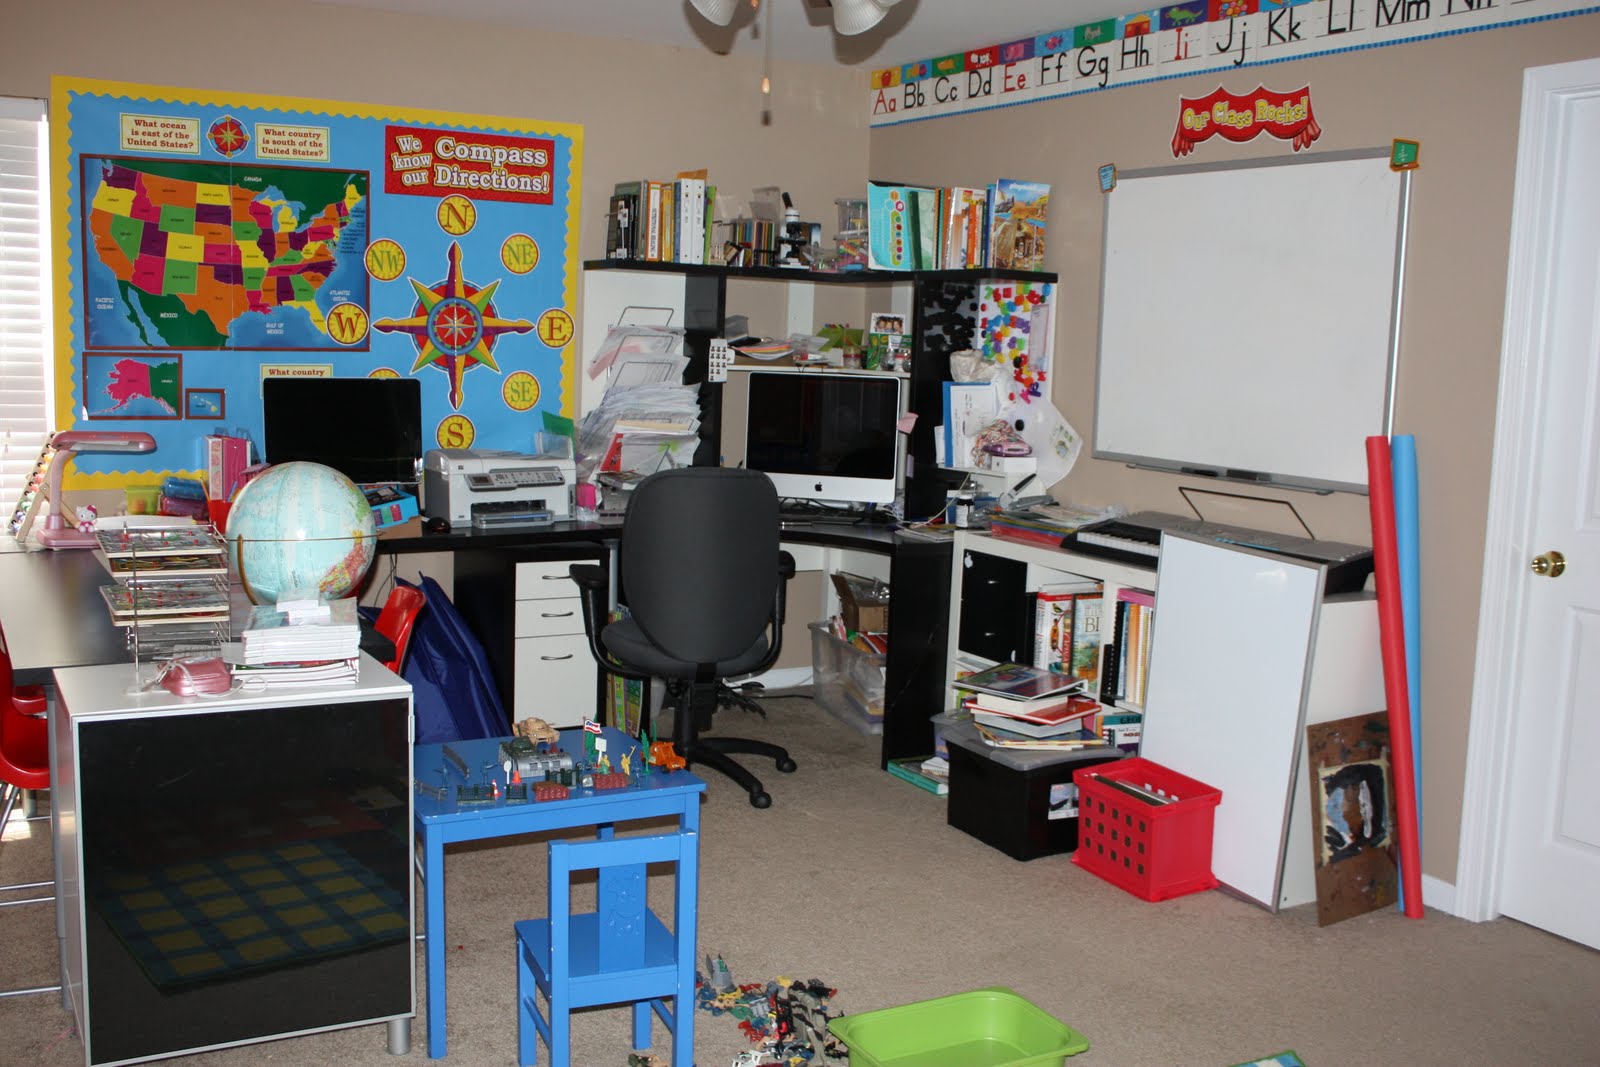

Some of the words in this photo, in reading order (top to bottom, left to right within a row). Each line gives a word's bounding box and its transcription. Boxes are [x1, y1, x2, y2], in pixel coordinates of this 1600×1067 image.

[873, 89, 896, 114] Aa
[904, 81, 925, 109] Bb
[935, 76, 958, 103] Cc
[968, 67, 992, 98] Dd
[1004, 63, 1026, 92] Ee
[1041, 52, 1067, 85] Ff
[1077, 46, 1109, 87] Gg
[1121, 35, 1149, 70] Hh
[1174, 27, 1189, 61] Ii
[1216, 18, 1247, 65] Jj
[1267, 7, 1300, 45] Kk
[1376, 0, 1430, 27] Mm
[134, 119, 158, 128] What
[160, 122, 187, 130] ocean
[1183, 108, 1210, 131] Our
[1212, 100, 1253, 129] Class
[1255, 95, 1309, 125] Rocks!
[127, 138, 158, 147] United
[160, 140, 194, 149] States?
[264, 128, 286, 137] What
[288, 131, 321, 140] country
[396, 135, 422, 153] We
[262, 147, 290, 155] United
[292, 148, 324, 156] States?
[391, 153, 432, 171] know
[435, 137, 547, 167] Compass
[402, 170, 428, 186] our
[434, 163, 550, 194] Directions!
[444, 202, 469, 230] N
[370, 249, 401, 273] NW
[505, 243, 535, 266] NE
[333, 312, 362, 339] W
[546, 316, 567, 341] E
[268, 367, 290, 376] What
[292, 368, 325, 377] country
[510, 381, 533, 403] SE
[446, 422, 465, 448] S
